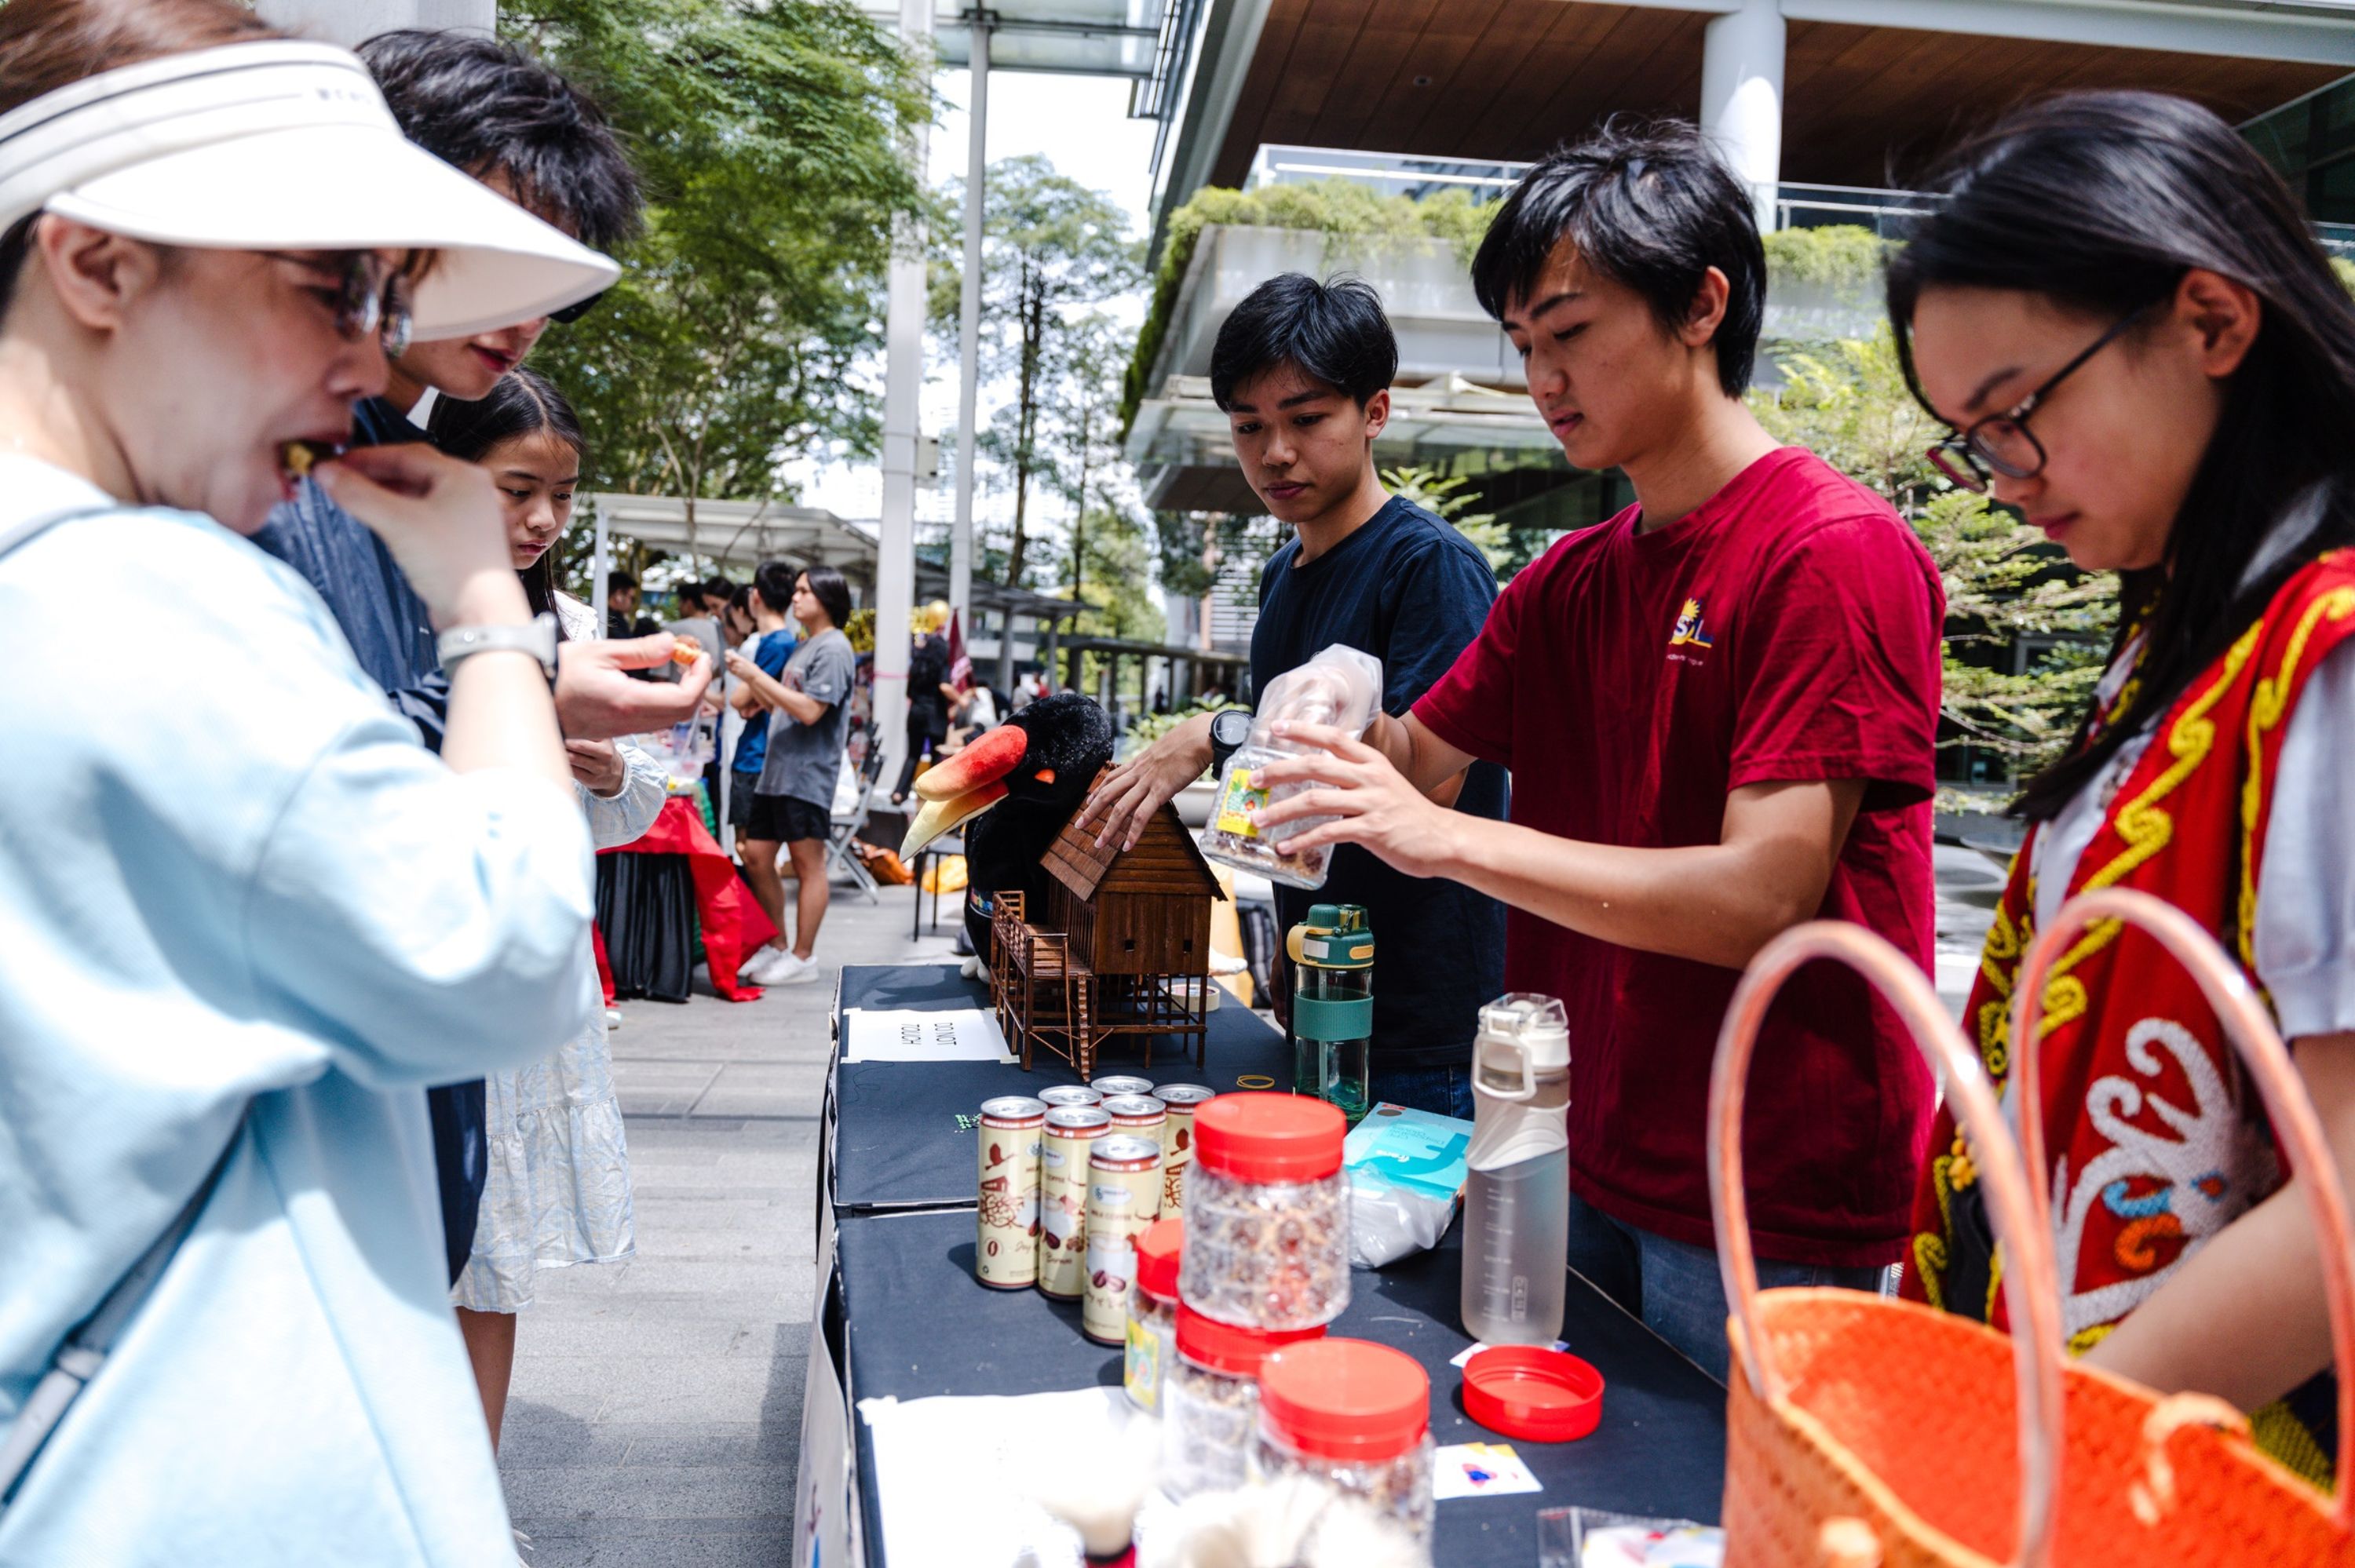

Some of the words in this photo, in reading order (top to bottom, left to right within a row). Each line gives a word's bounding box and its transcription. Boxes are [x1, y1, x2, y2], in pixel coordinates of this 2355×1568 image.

[901, 1023, 922, 1045] TOUCH
[934, 1023, 954, 1031] DO
[935, 1031, 957, 1045] NOT
